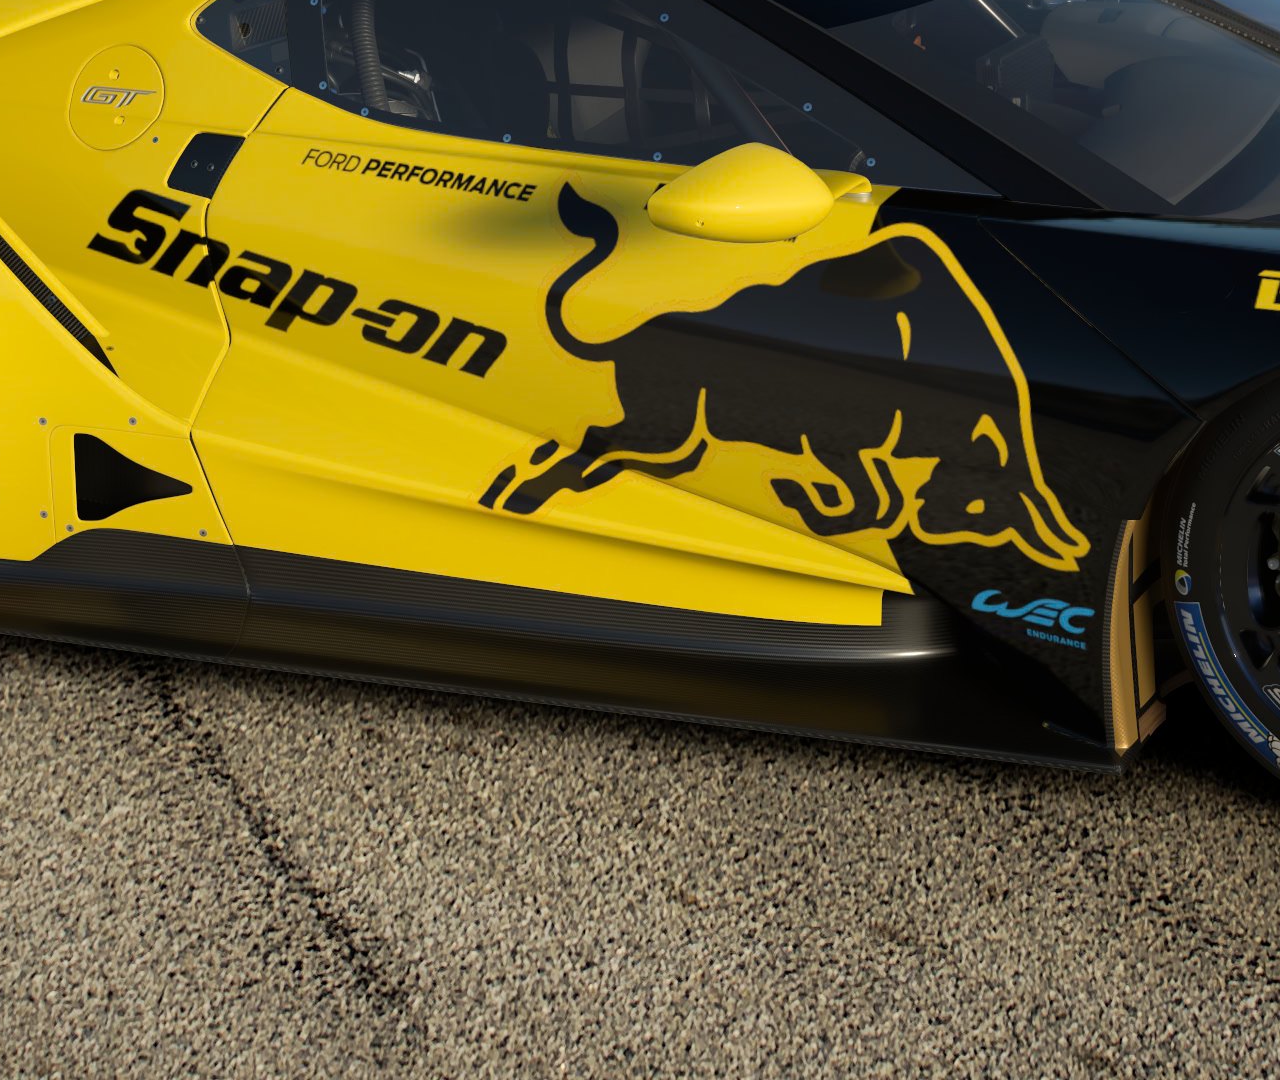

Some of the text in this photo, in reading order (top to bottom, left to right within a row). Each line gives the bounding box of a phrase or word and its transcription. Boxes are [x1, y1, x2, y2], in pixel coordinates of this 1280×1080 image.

[80, 85, 157, 109] GT
[301, 148, 537, 202] FORD PERFORMANCE
[86, 189, 508, 379] Snap-on
[1176, 517, 1187, 566] MICHELIN
[970, 588, 1097, 635] WEC
[1025, 628, 1088, 652] ENDURANCE
[1180, 608, 1267, 745] MICHELIN
